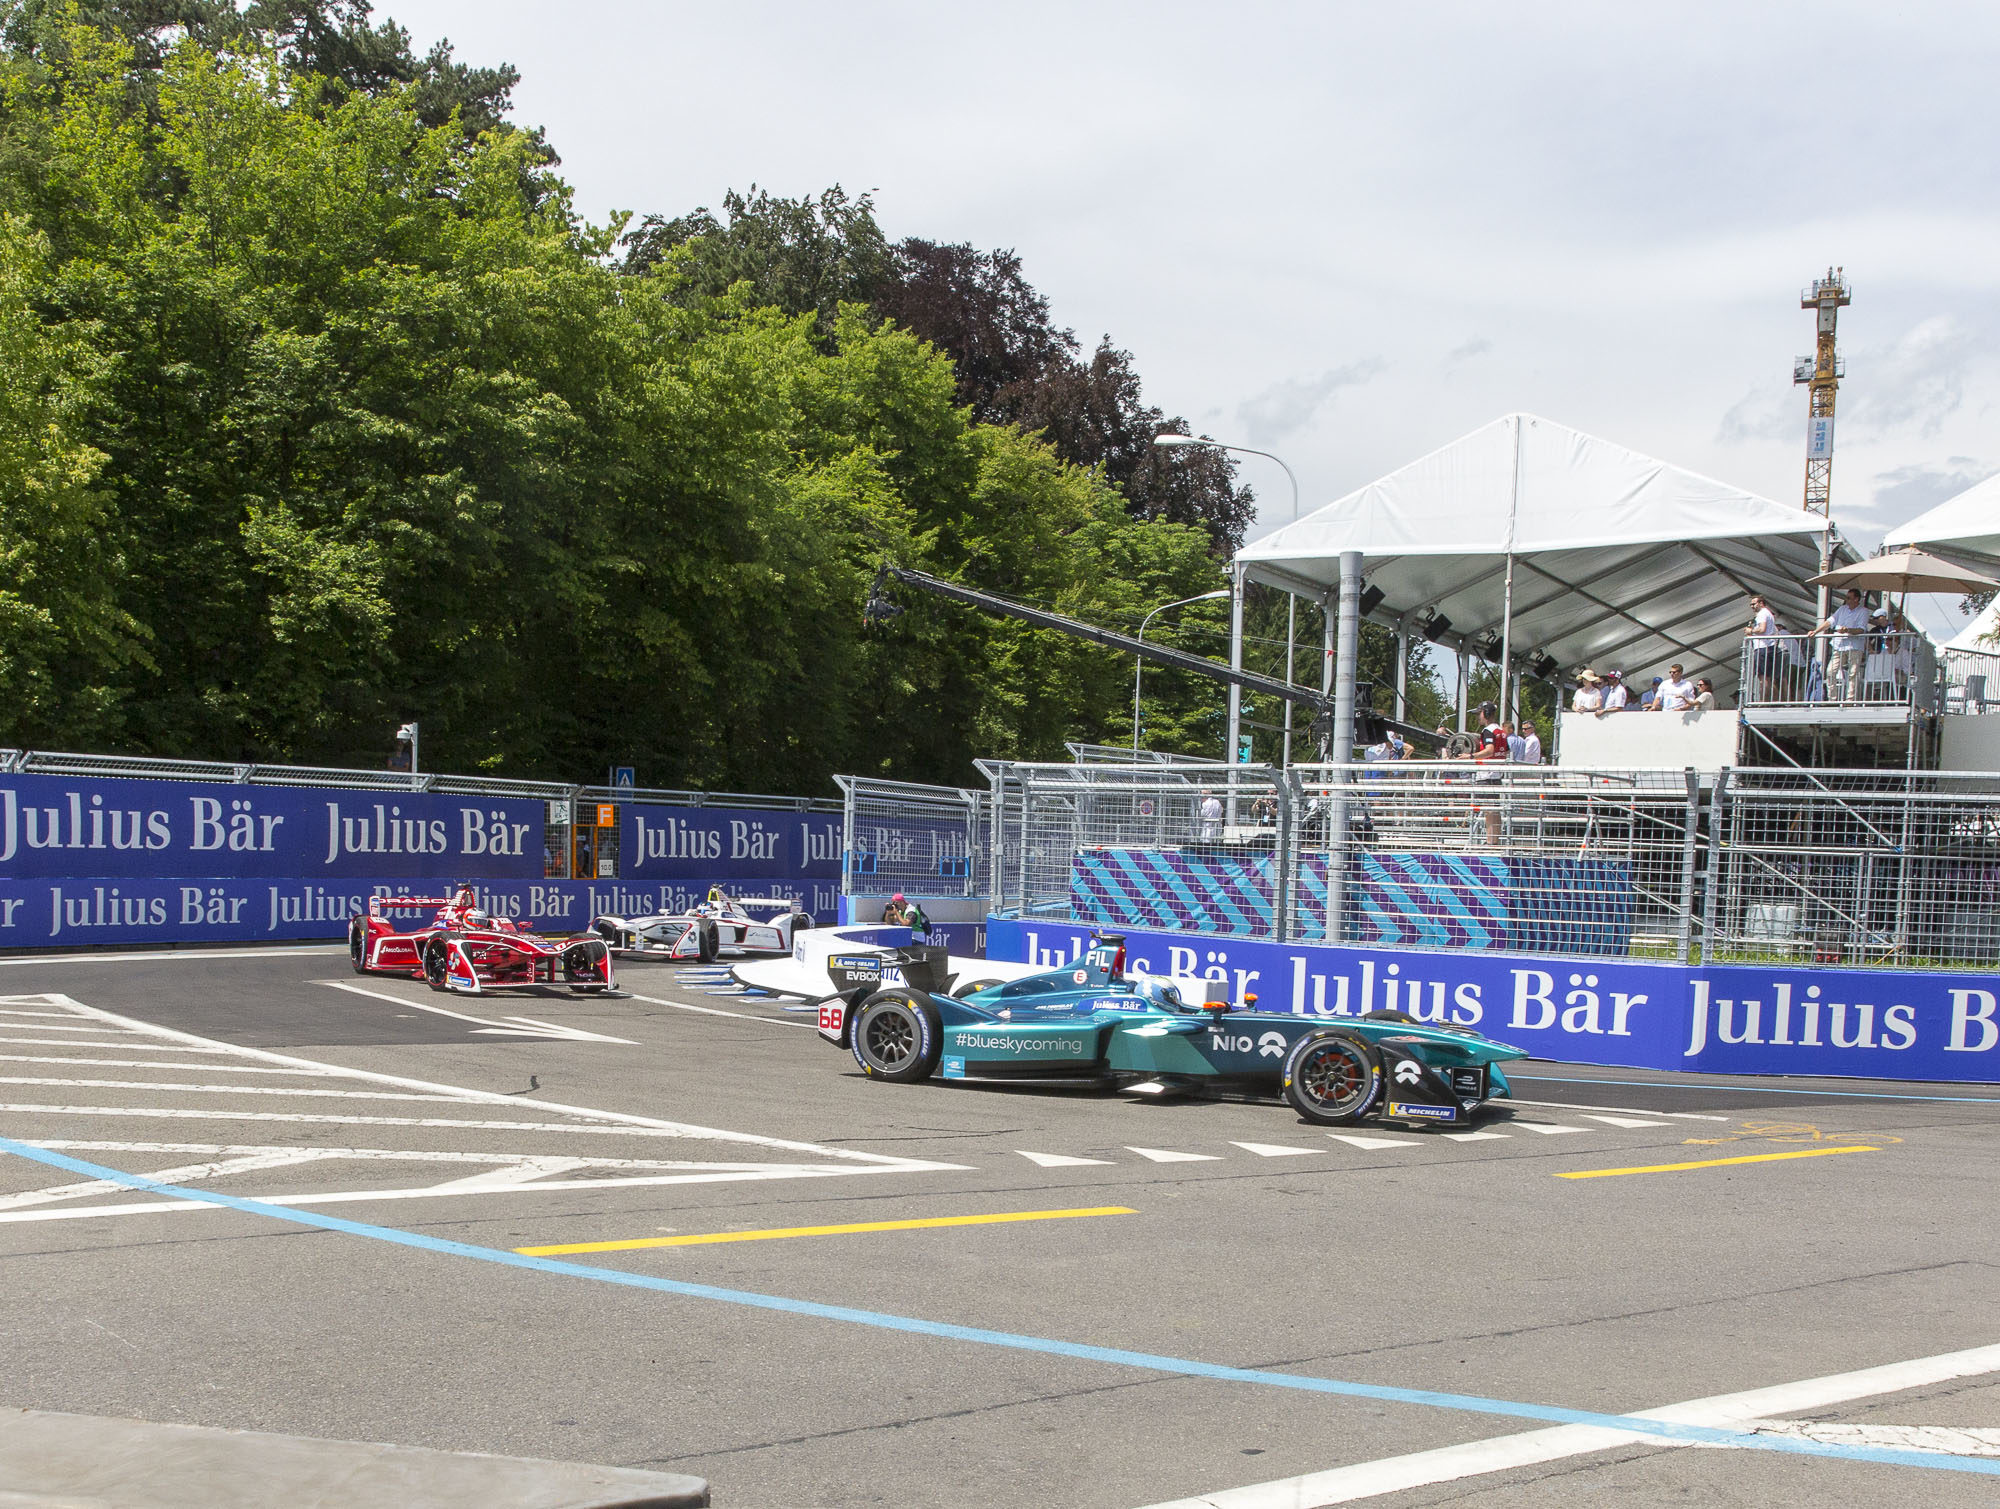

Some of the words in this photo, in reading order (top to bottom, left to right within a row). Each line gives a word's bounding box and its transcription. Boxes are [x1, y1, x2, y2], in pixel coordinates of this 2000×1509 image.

[0, 789, 171, 861] Julius
[189, 797, 284, 852] Bär
[600, 808, 611, 823] F
[325, 802, 447, 864] Julius
[461, 808, 530, 856] Bär
[634, 816, 721, 868] Julius
[730, 820, 780, 859] Bär
[801, 823, 868, 869] Julis
[874, 826, 914, 862] Bär
[50, 888, 166, 937] Julius
[179, 887, 247, 924] Bär
[268, 887, 363, 931] Julius
[529, 886, 575, 917] Bär
[588, 887, 651, 923] Julius
[660, 886, 699, 915] Bär
[813, 885, 842, 916] Juli
[1085, 950, 1110, 967] FIL
[846, 971, 880, 981] EVBOX
[1027, 932, 1150, 976] Juls
[1290, 957, 1483, 1026] Julius
[1508, 969, 1648, 1036] Bär
[1122, 1001, 1141, 1010] Bär
[819, 1008, 842, 1030] 68
[1684, 980, 1917, 1056] Julius
[955, 1033, 1082, 1054] #blueskycoming
[1213, 1035, 1253, 1053] NIO
[1408, 1108, 1450, 1117] MICHELIN
